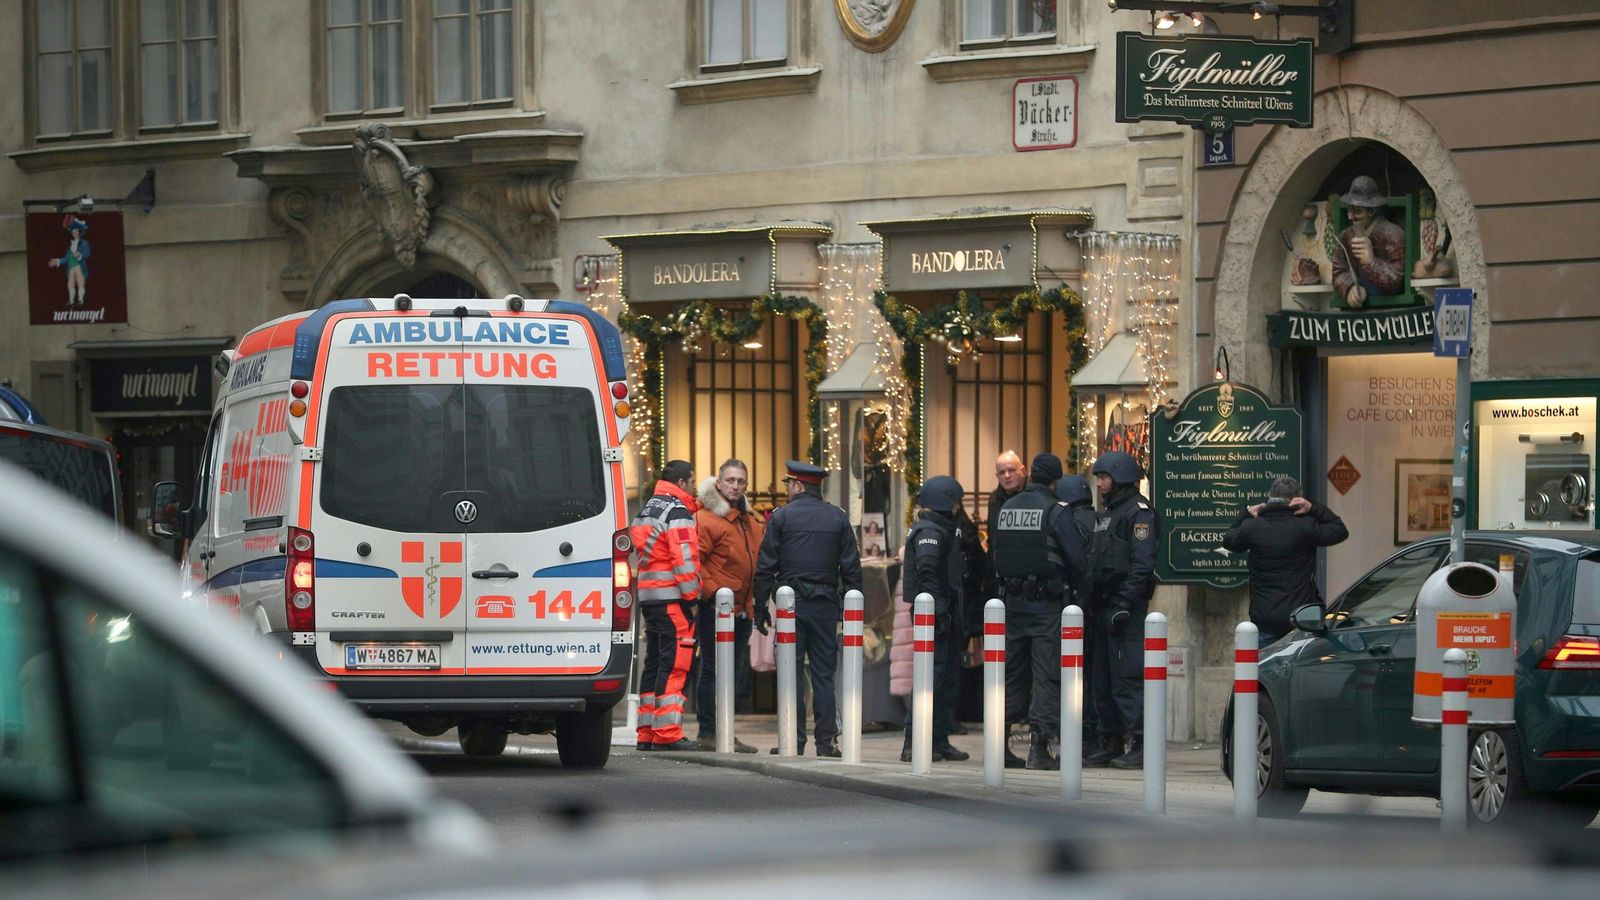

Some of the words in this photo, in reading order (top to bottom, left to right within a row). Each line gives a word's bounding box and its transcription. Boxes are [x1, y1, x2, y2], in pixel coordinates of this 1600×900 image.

[1139, 48, 1298, 94] Figlmüller
[1144, 93, 1162, 106] Das
[1164, 95, 1219, 108] berühmteste
[1221, 96, 1263, 110] Schnitzel
[1265, 97, 1294, 110] Wiens
[1212, 132, 1225, 155] 5
[912, 249, 1006, 274] BANDOLERA
[653, 261, 741, 286] BANDOLERA
[348, 321, 570, 346] AMBULANCE
[1288, 316, 1331, 342] ZUM
[1337, 310, 1436, 343] FIGLMÜLLE
[367, 352, 557, 379] RETTUNG
[1369, 377, 1442, 390] BESUCHEN
[1368, 393, 1388, 406] DIE
[1492, 405, 1579, 419] www.boschek.at
[1168, 420, 1286, 450] Figlmüller
[1411, 426, 1424, 437] IN
[1165, 452, 1179, 461] Das
[1181, 452, 1226, 461] berühmteste
[1228, 452, 1262, 461] Schnitzel
[1265, 452, 1289, 461] Wiens
[1165, 471, 1178, 480] The
[1198, 471, 1222, 480] famous
[1223, 471, 1254, 480] Schnitzel
[1165, 490, 1199, 501] L'escalope
[1201, 490, 1210, 498] de
[1211, 490, 1236, 499] Vienne
[1238, 490, 1245, 498] la
[1247, 490, 1262, 501] plus
[999, 510, 1041, 528] POLIZEI
[1187, 508, 1213, 517] famoso
[918, 538, 938, 546] POLIZEI
[1180, 530, 1226, 542] BÄCKERS
[1192, 559, 1213, 569] täglich
[528, 590, 606, 620] 144
[331, 611, 386, 619] CRAFTER
[1453, 625, 1488, 634] BRAUCHE
[1453, 635, 1474, 644] MEHR
[1475, 635, 1497, 644] INPUT.
[357, 649, 368, 663] W
[378, 649, 414, 663] 4867
[417, 649, 437, 663] MA
[471, 642, 601, 656] www.rettung.wien.at
